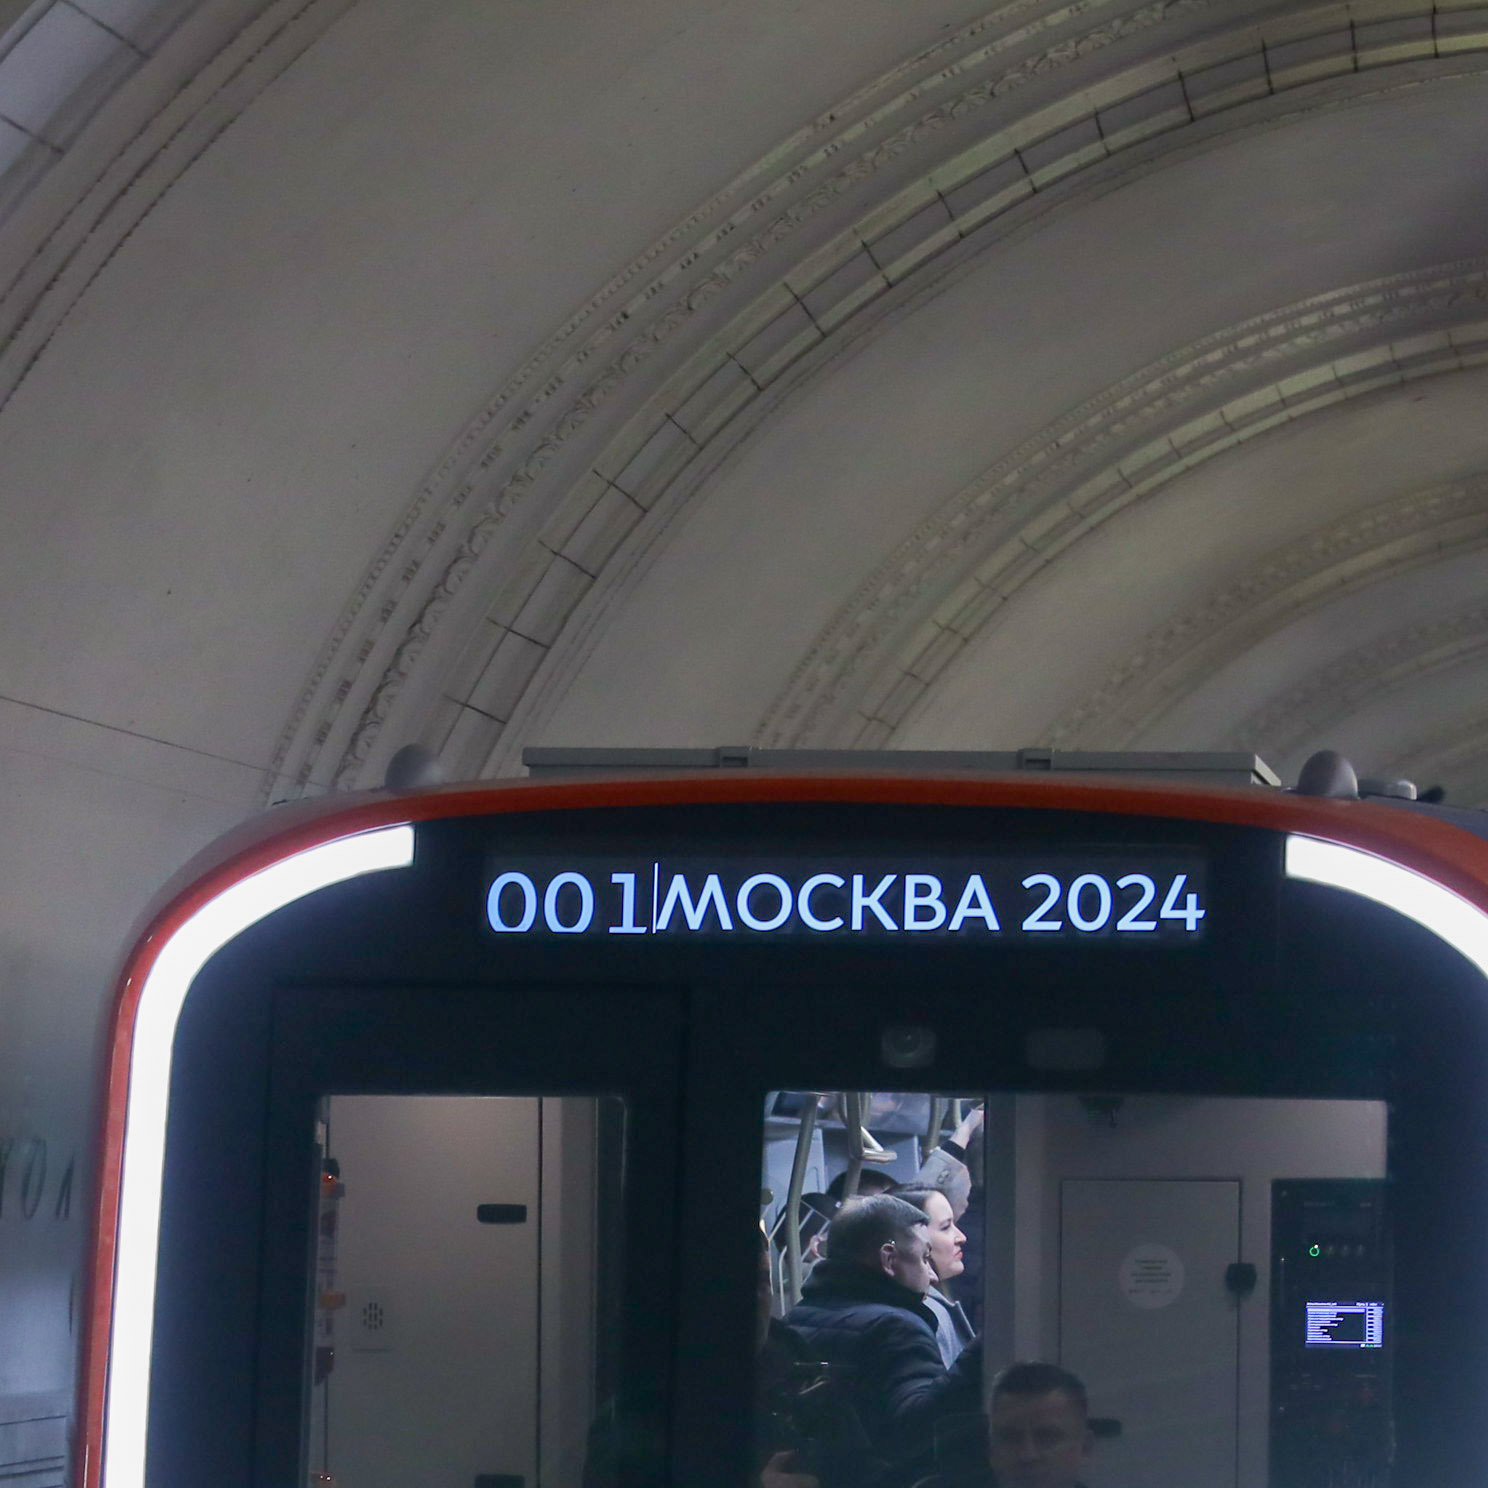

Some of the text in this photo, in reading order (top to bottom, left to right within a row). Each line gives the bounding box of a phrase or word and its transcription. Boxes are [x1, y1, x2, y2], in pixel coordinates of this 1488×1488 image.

[488, 872, 1206, 933] 001 МОСКВА 2024
